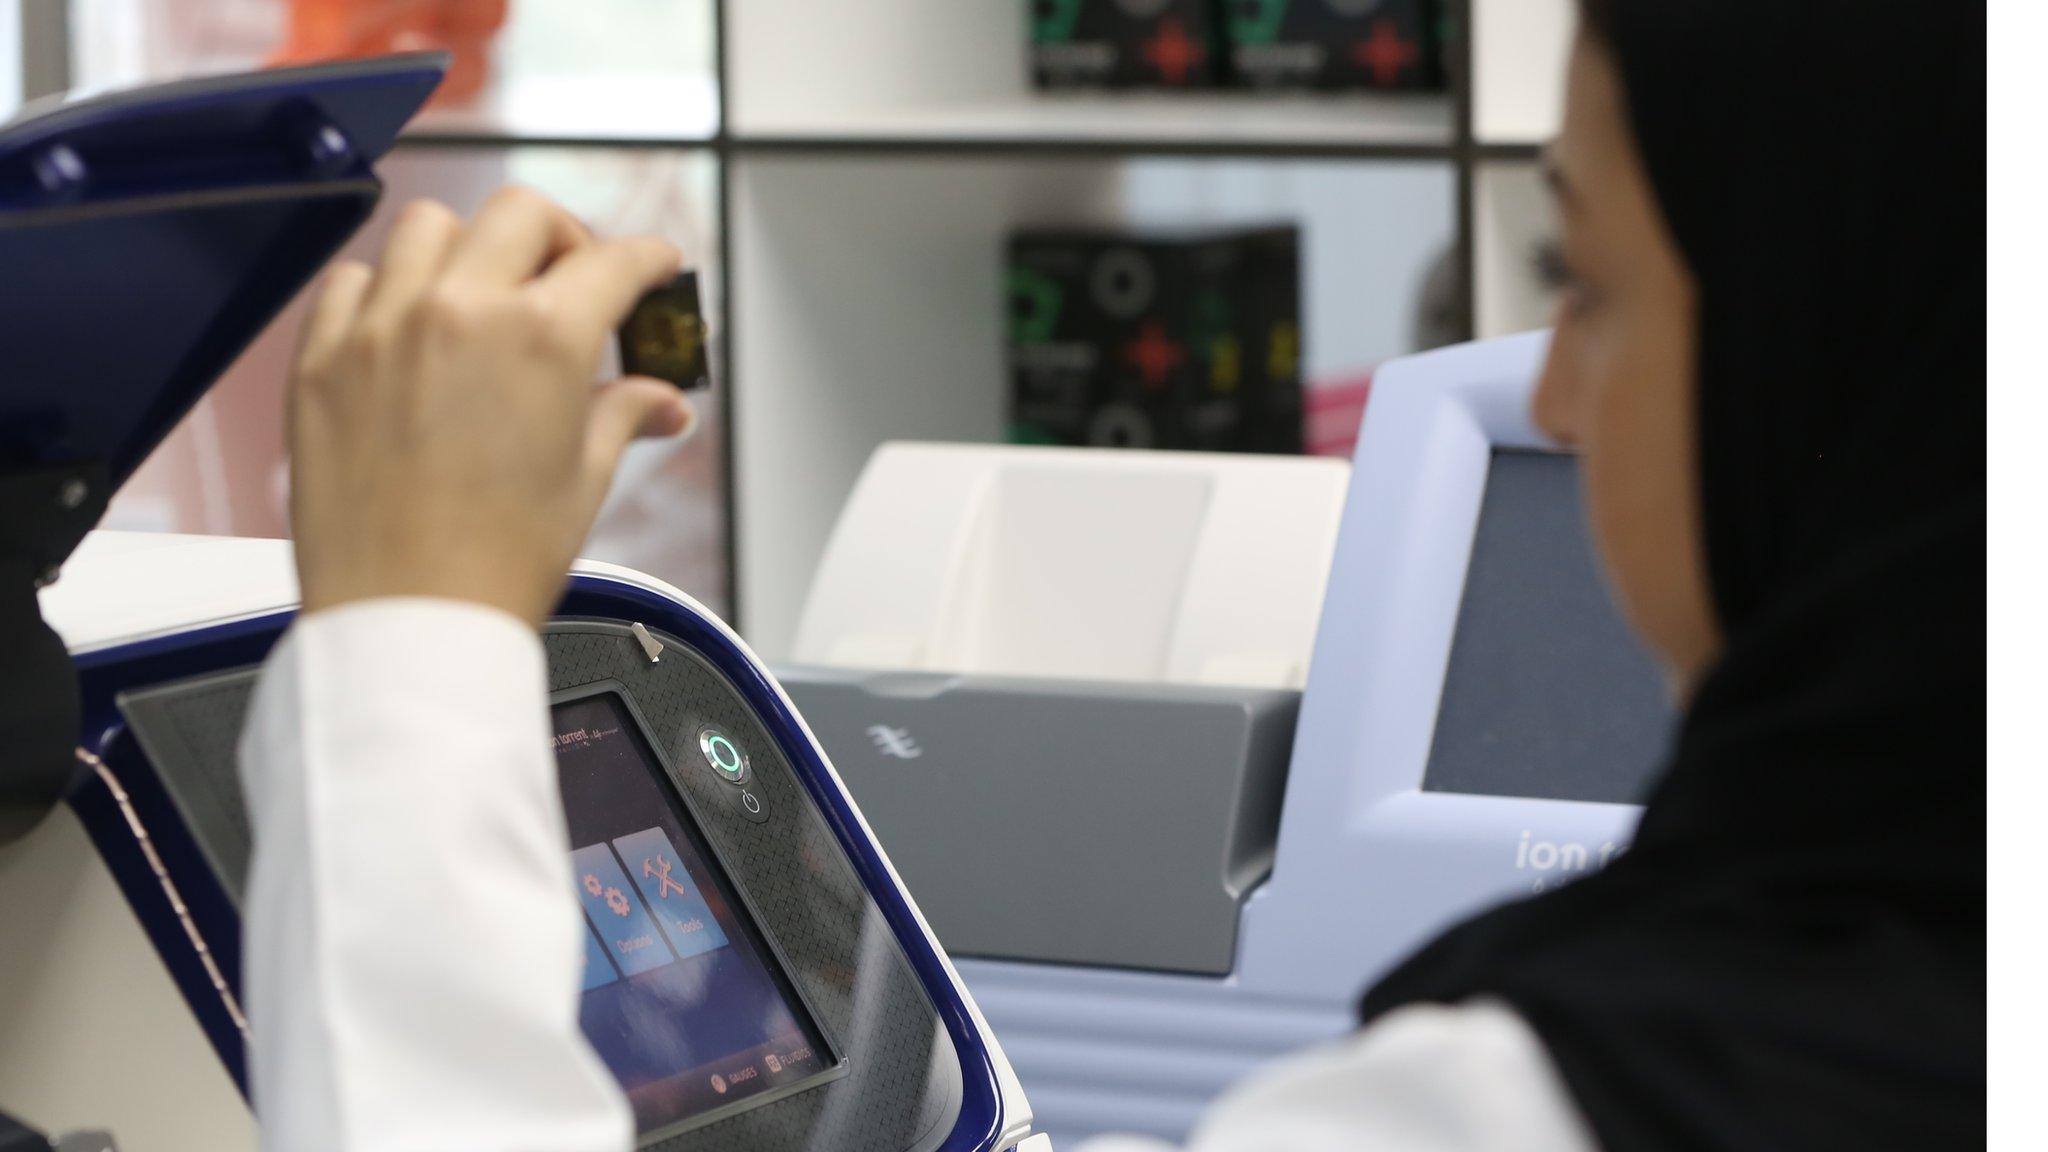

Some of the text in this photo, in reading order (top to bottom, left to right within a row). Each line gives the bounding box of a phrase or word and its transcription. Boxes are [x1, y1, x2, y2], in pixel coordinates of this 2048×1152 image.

[559, 728, 589, 744] torrent
[1515, 829, 1588, 871] ion
[677, 918, 704, 934] Tools
[616, 936, 653, 954] Options
[728, 1067, 758, 1084] GAUGES
